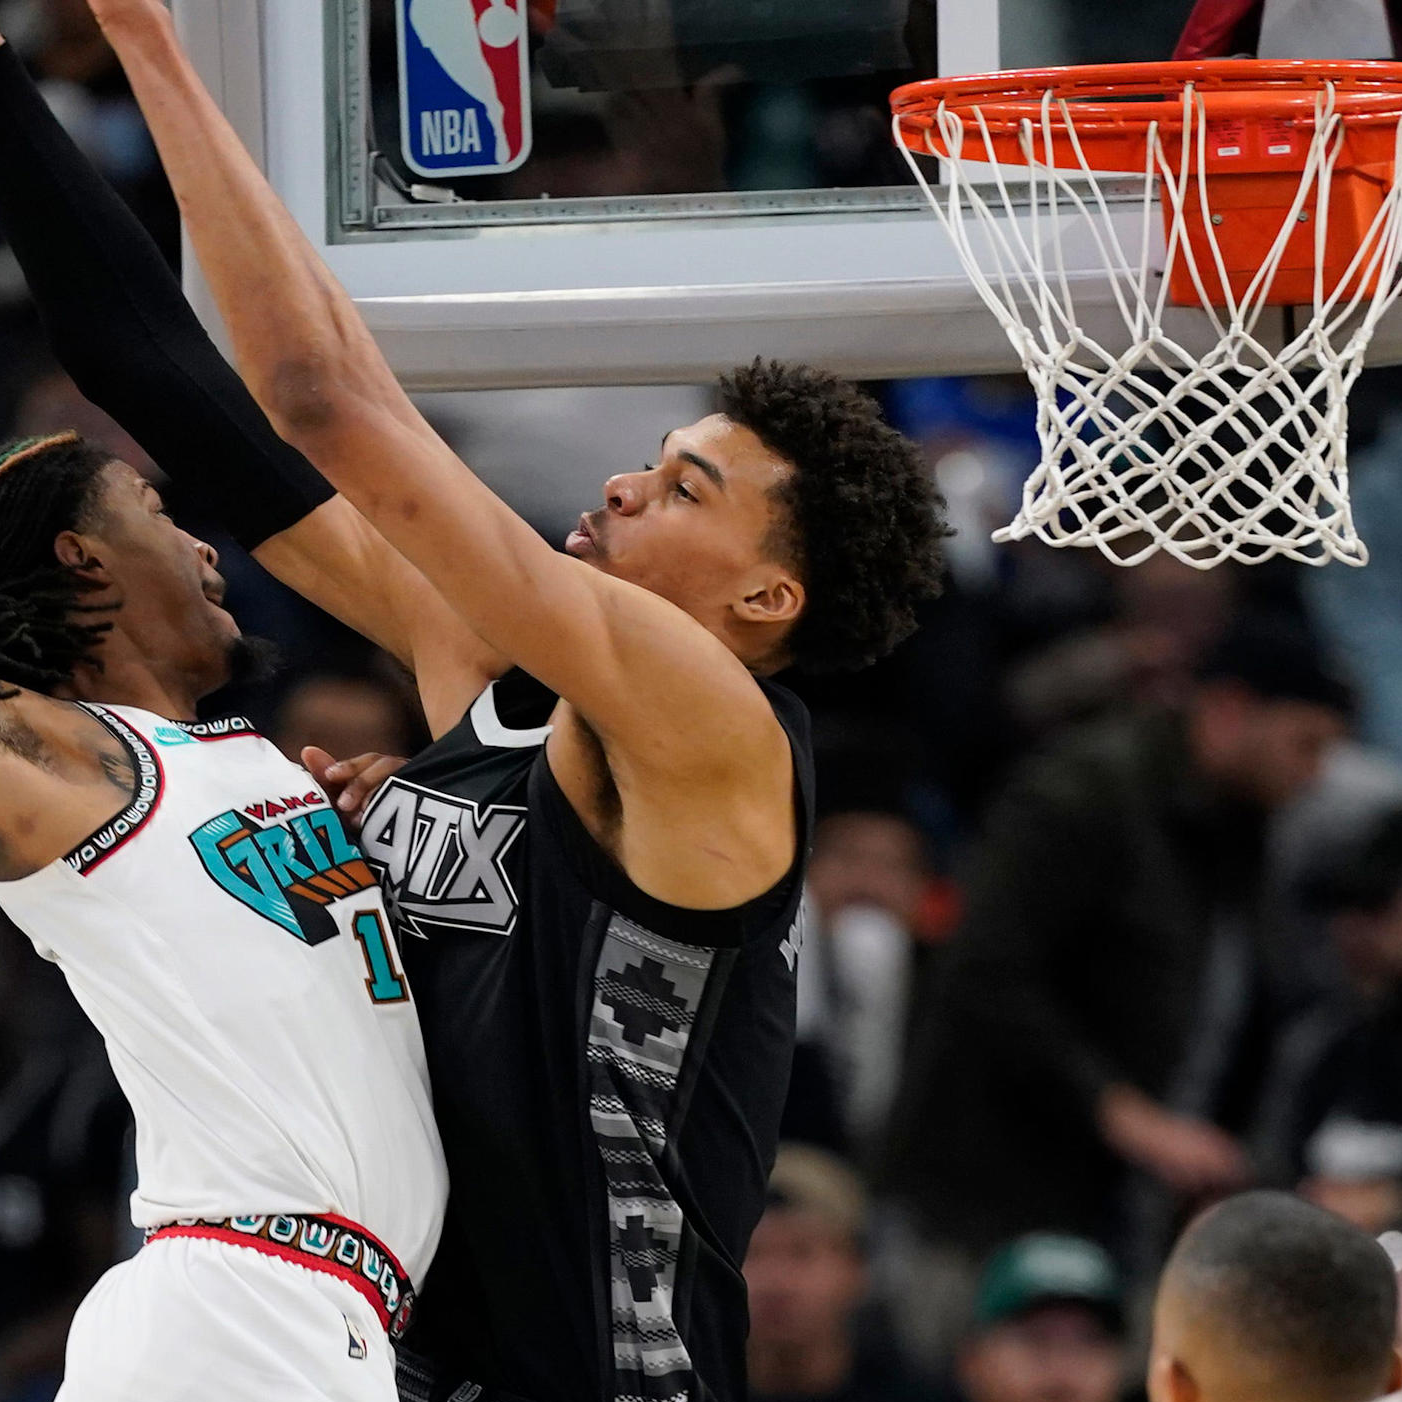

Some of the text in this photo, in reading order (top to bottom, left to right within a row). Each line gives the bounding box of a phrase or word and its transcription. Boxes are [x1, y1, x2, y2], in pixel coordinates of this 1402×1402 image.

[420, 108, 482, 156] NBA
[244, 790, 325, 821] VANC
[362, 777, 528, 937] ATX
[352, 909, 410, 1005] 1
